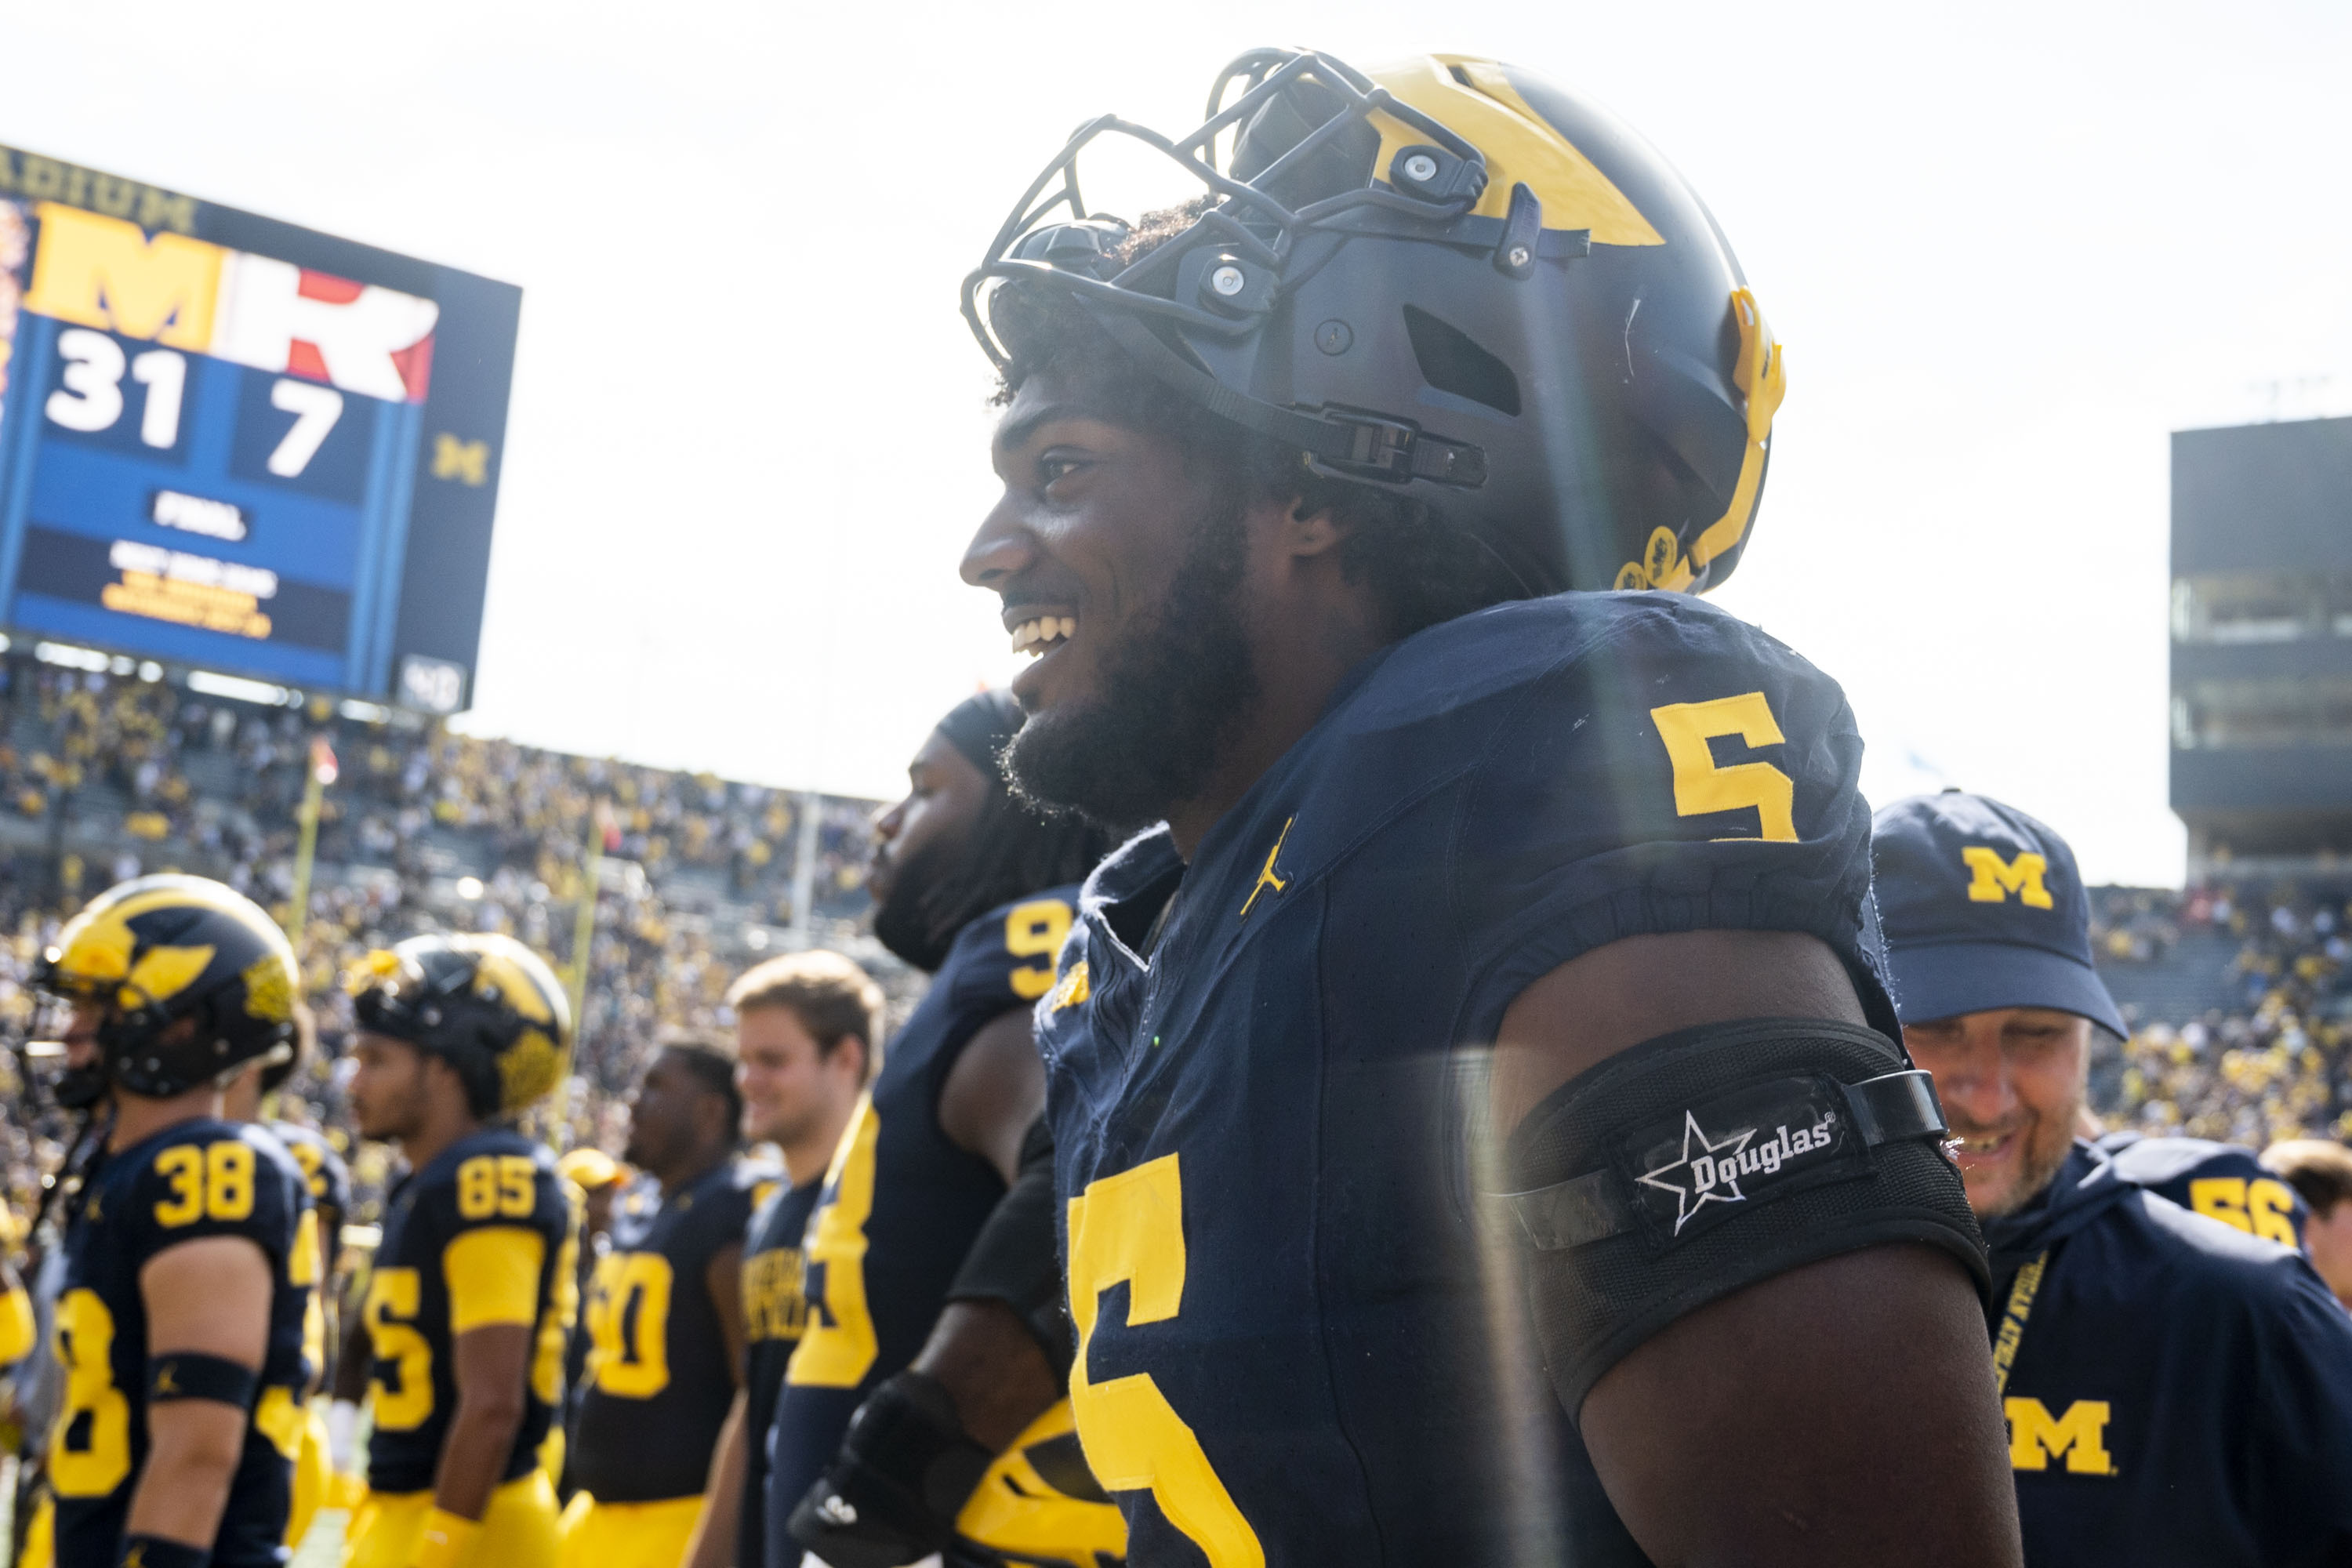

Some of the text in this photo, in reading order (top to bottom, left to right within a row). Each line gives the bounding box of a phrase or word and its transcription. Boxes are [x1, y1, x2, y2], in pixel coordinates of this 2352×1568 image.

[45, 328, 187, 449] 31
[267, 378, 344, 477] 7
[1650, 691, 1799, 843] 5
[1962, 846, 2053, 909] M
[153, 1141, 256, 1228] 38
[456, 1155, 537, 1219] 85
[1690, 1121, 1832, 1187] Douglas
[2190, 1177, 2297, 1248] 56
[2004, 1396, 2111, 1475] M
